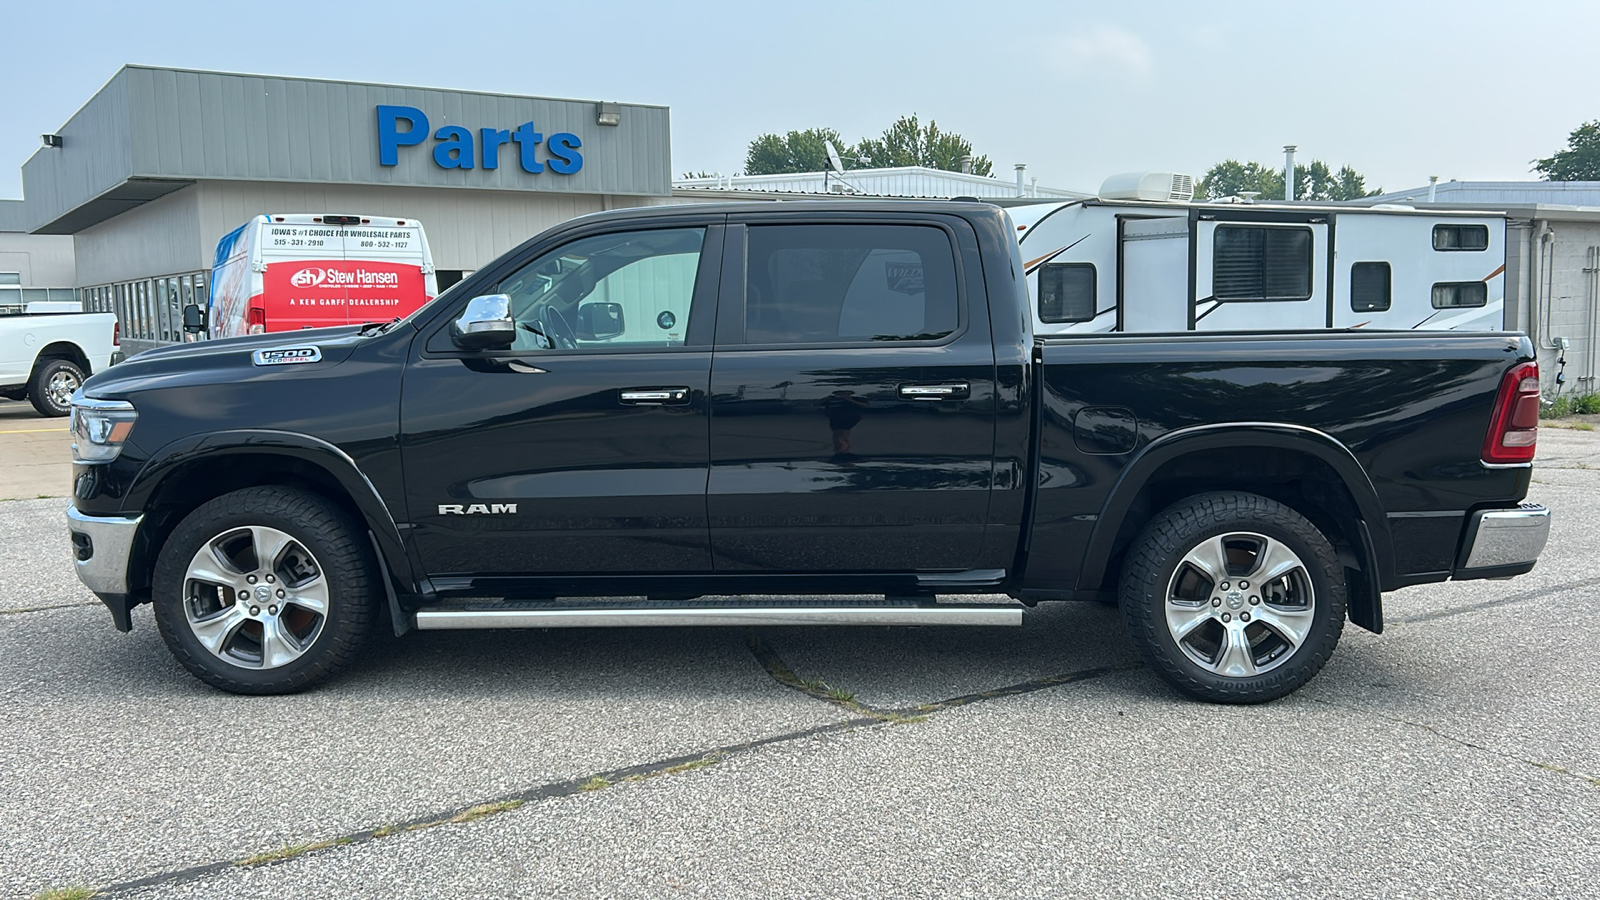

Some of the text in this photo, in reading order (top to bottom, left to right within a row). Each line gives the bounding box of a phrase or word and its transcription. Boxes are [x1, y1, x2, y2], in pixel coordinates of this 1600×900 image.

[376, 104, 584, 175] Parts
[271, 228, 298, 236] IOWA'S
[308, 229, 335, 237] CHOICE
[350, 230, 389, 238] WHOLESALE
[389, 231, 411, 239] PARTS
[326, 268, 398, 284] Stew Hansen
[290, 298, 399, 306] A KEN GARFF DEALERSHIP
[263, 349, 312, 359] 1500
[438, 503, 518, 515] RAM
